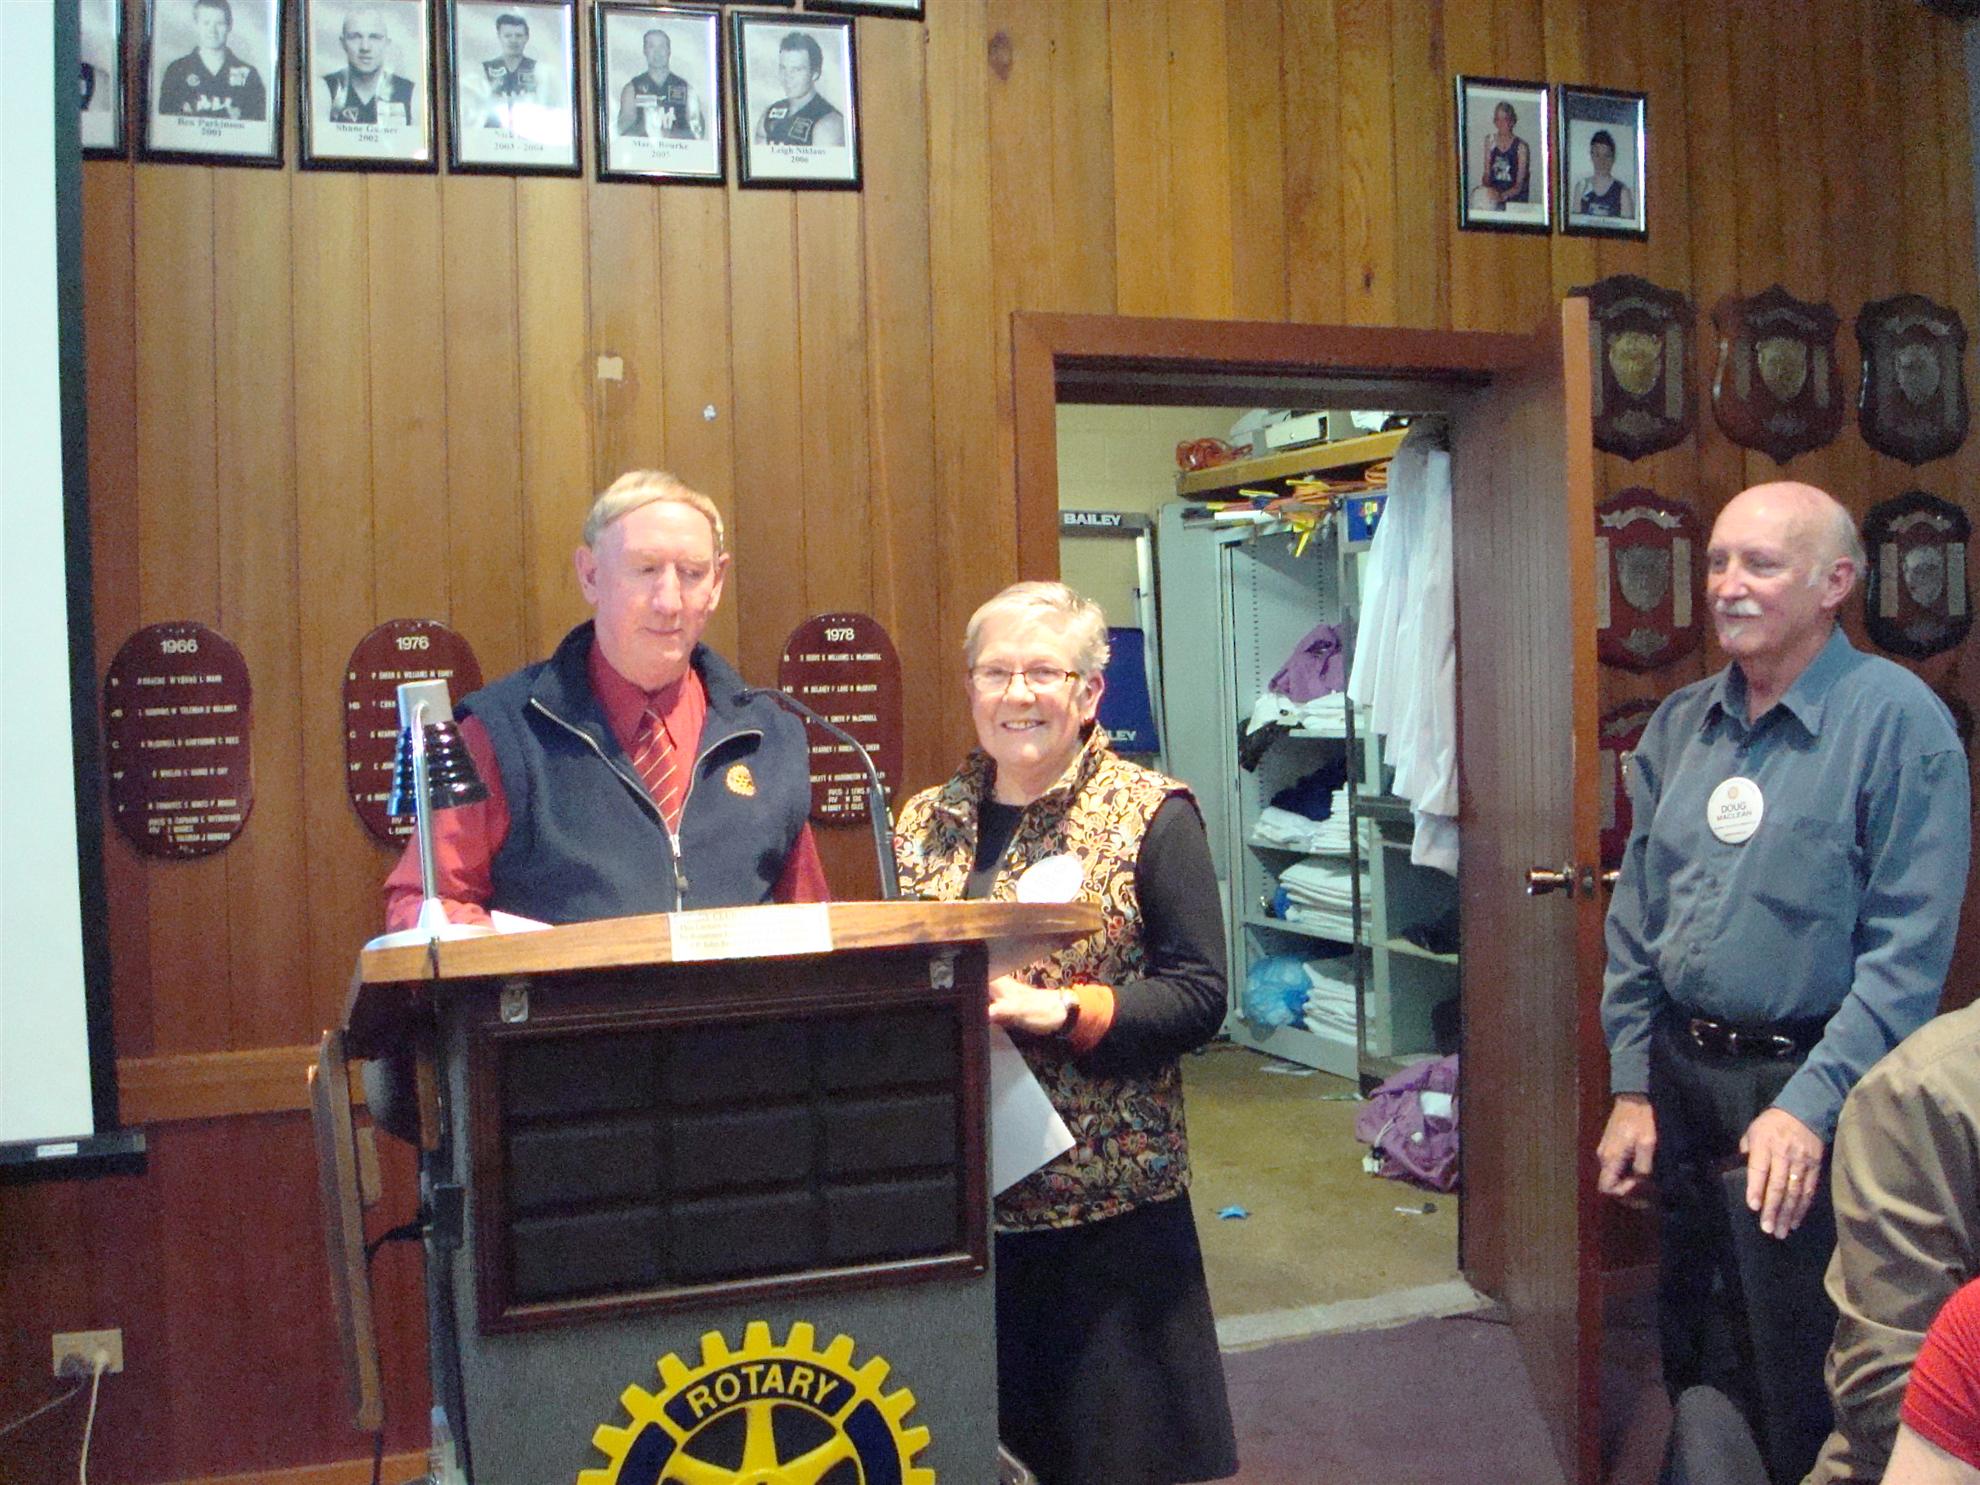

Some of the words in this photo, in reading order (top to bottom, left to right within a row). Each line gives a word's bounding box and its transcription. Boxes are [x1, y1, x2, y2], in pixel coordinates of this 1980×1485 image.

[358, 134, 379, 143] 2002
[1063, 513, 1121, 527] BAILEY
[824, 628, 854, 641] 1978
[160, 639, 198, 654] 1966
[396, 636, 430, 650] 1976
[1107, 730, 1137, 741] LEY
[1721, 801, 1747, 814] DOUG
[685, 1364, 840, 1419] ROTARY
